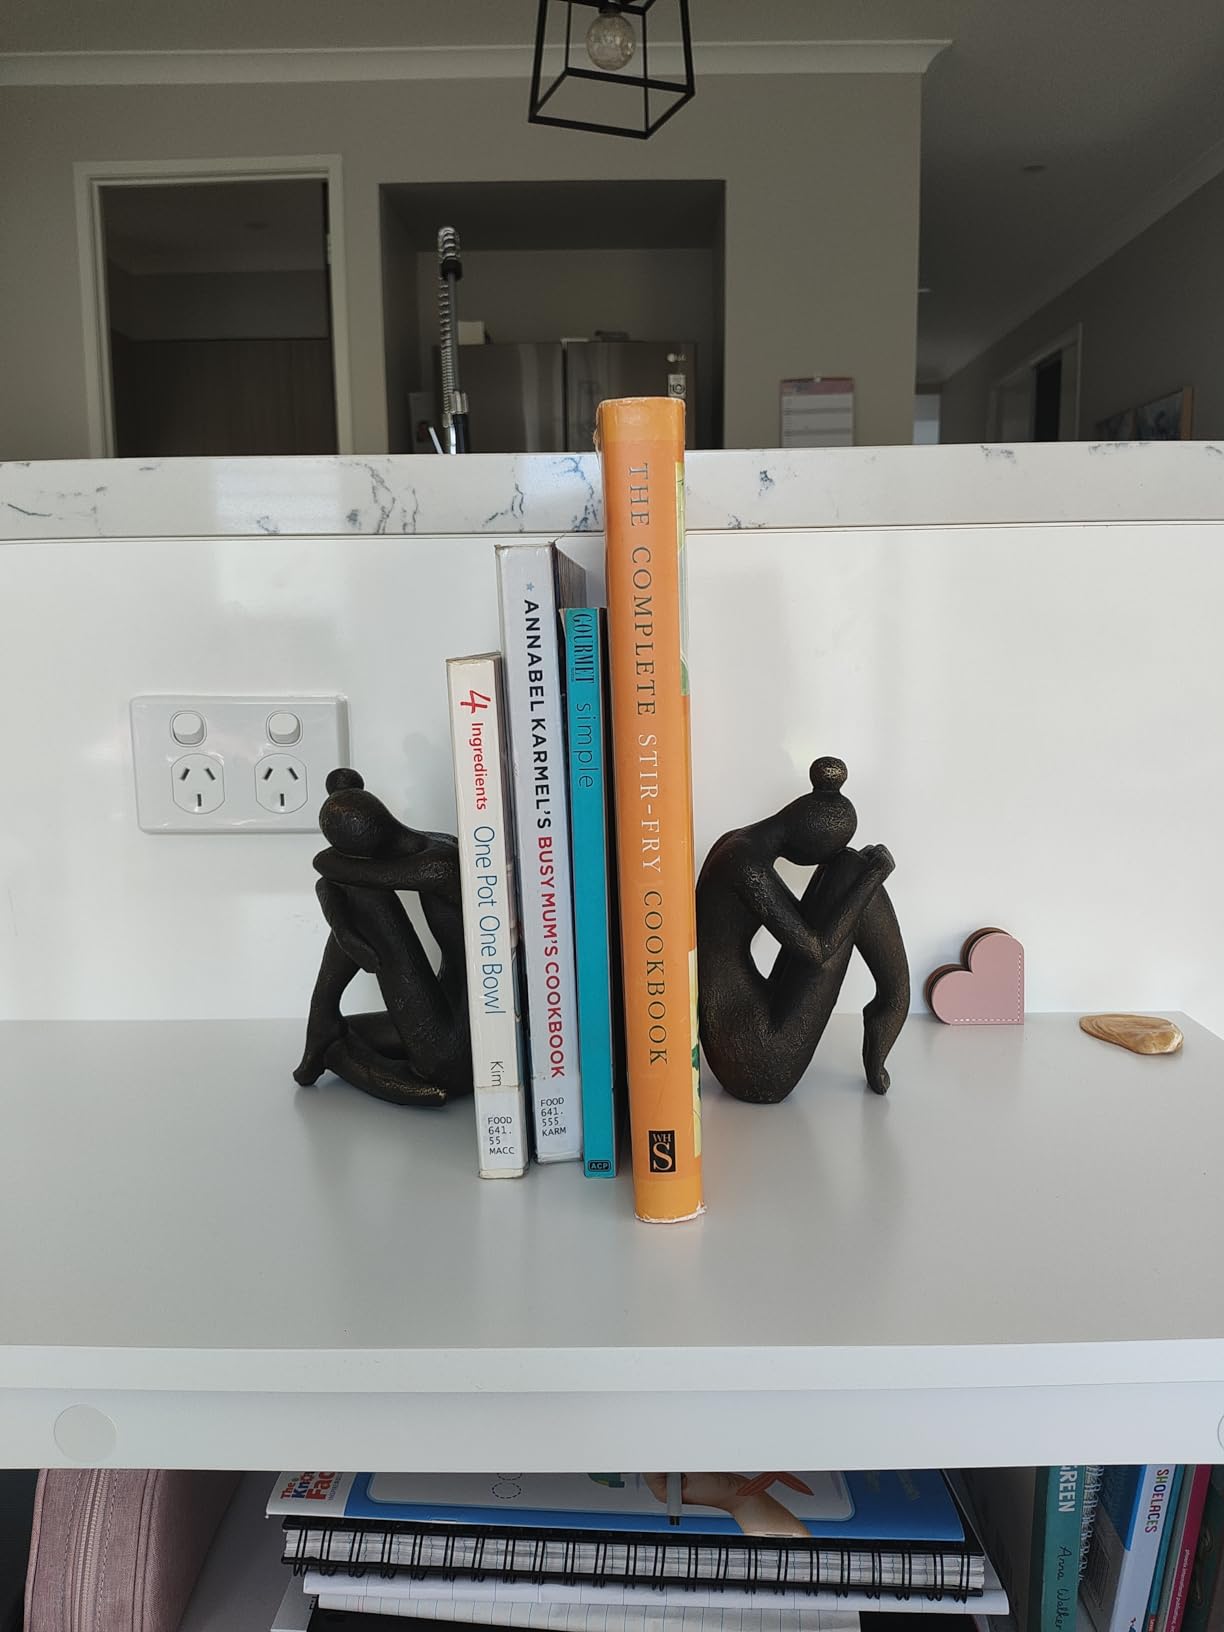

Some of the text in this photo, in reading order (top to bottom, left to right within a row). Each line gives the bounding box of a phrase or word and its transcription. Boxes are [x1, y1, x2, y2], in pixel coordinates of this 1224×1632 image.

[572, 613, 595, 684] GOURMET
[460, 689, 491, 811] 4 Ingredients
[572, 702, 599, 789] simple
[628, 463, 668, 1064] THE COMPLETE STIR-FRY COOKBOOK
[524, 600, 565, 1078] ANNABEL KARMEL'S BUSY MUM'S COOKBOOK
[473, 826, 506, 1014] One Pot One Bowl
[490, 1061, 505, 1087] Kim
[540, 1097, 565, 1107] FOOD
[487, 1116, 513, 1125] FOOD
[540, 1107, 564, 1117] 641.
[488, 1126, 512, 1135] 641.
[542, 1117, 560, 1127] 555
[489, 1136, 501, 1145] 55
[542, 1127, 567, 1137] KARM
[489, 1146, 515, 1155] MACC
[590, 1162, 608, 1170] ACP
[280, 1482, 296, 1499] The
[1145, 1468, 1169, 1534] SHOELACES
[1054, 1545, 1073, 1632] Anna Walker
